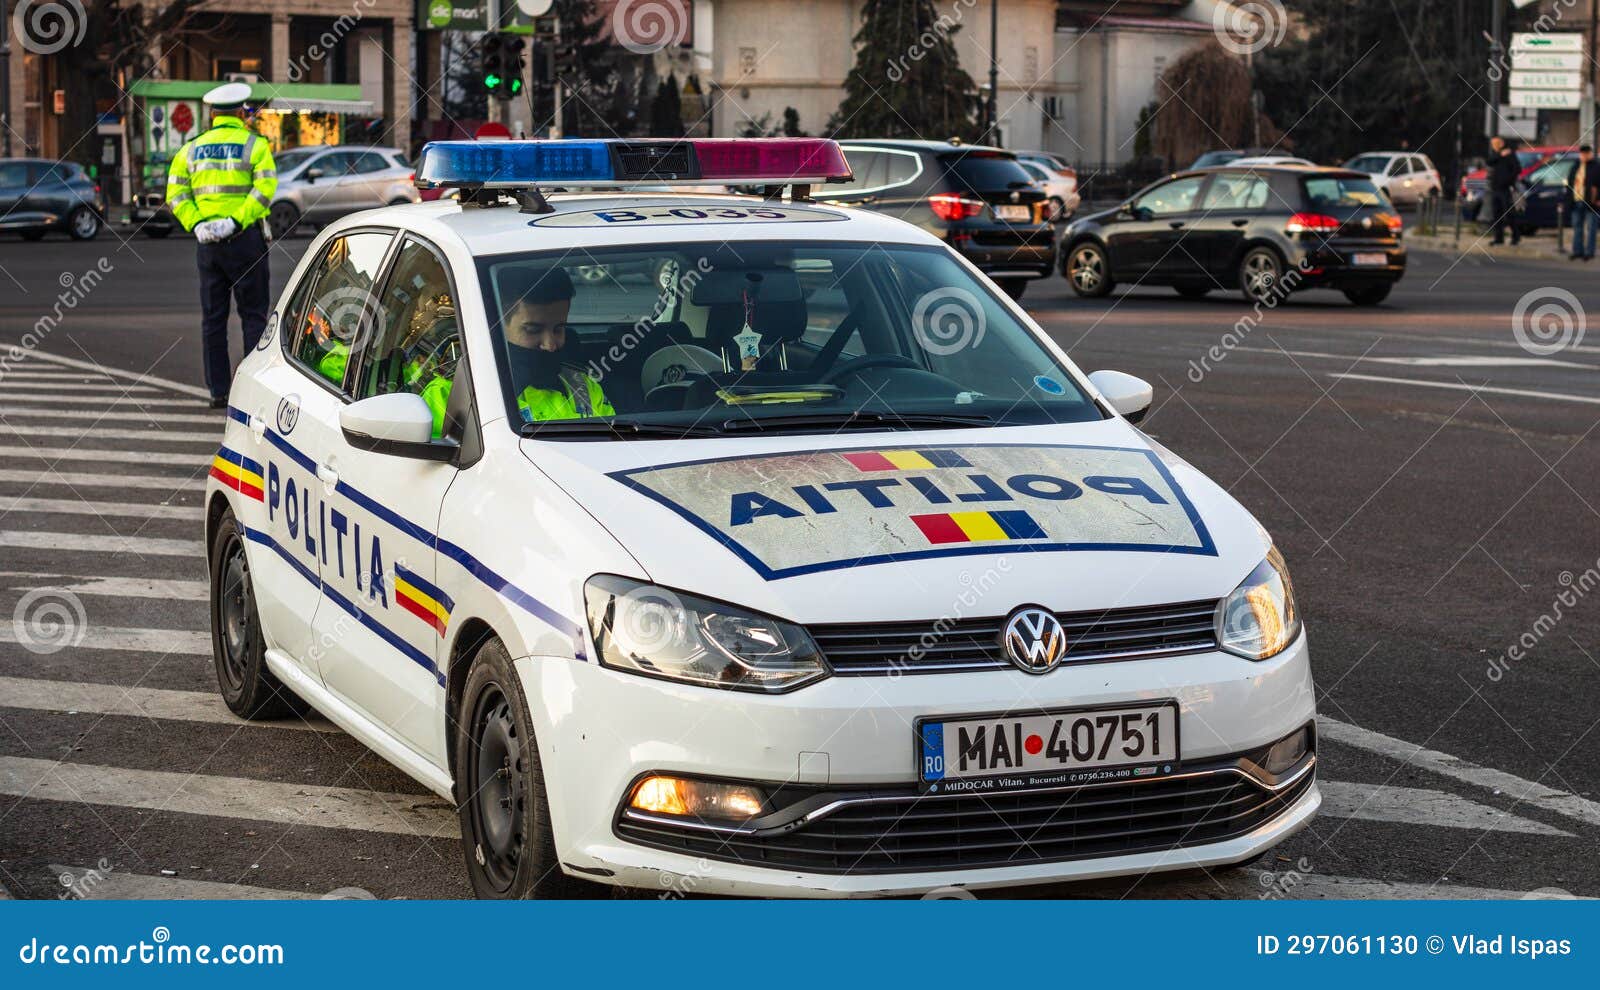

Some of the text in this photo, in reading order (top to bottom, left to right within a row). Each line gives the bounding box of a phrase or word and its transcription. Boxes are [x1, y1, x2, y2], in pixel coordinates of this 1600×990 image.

[592, 207, 787, 224] B-035
[268, 460, 389, 610] POLITIA
[958, 712, 1160, 771] MAI 40751
[924, 755, 943, 774] RO
[944, 780, 994, 792] MIDOCAR
[1029, 774, 1067, 785] Bucuresti
